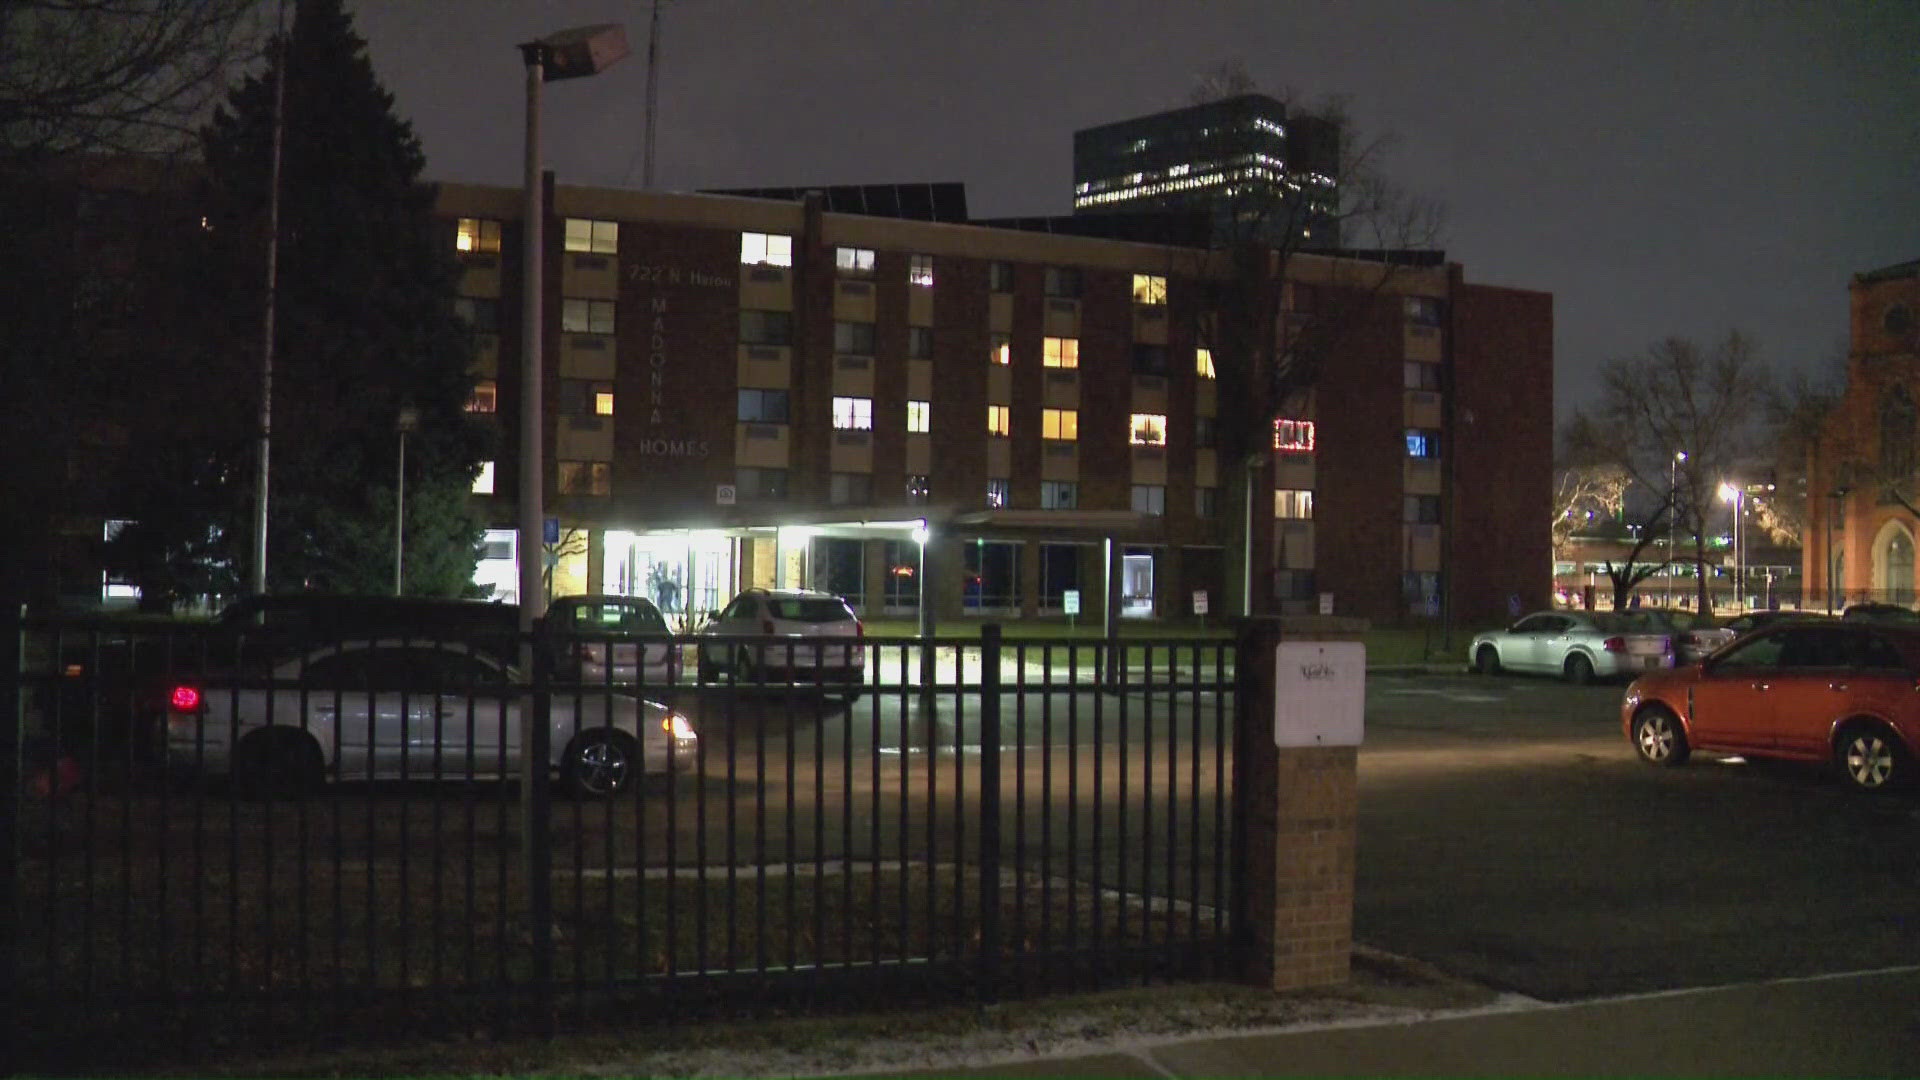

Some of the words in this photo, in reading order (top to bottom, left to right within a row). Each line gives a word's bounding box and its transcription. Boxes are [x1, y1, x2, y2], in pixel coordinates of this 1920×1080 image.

[629, 264, 662, 281] 722
[670, 269, 681, 284] N
[640, 439, 709, 456] HOMES
